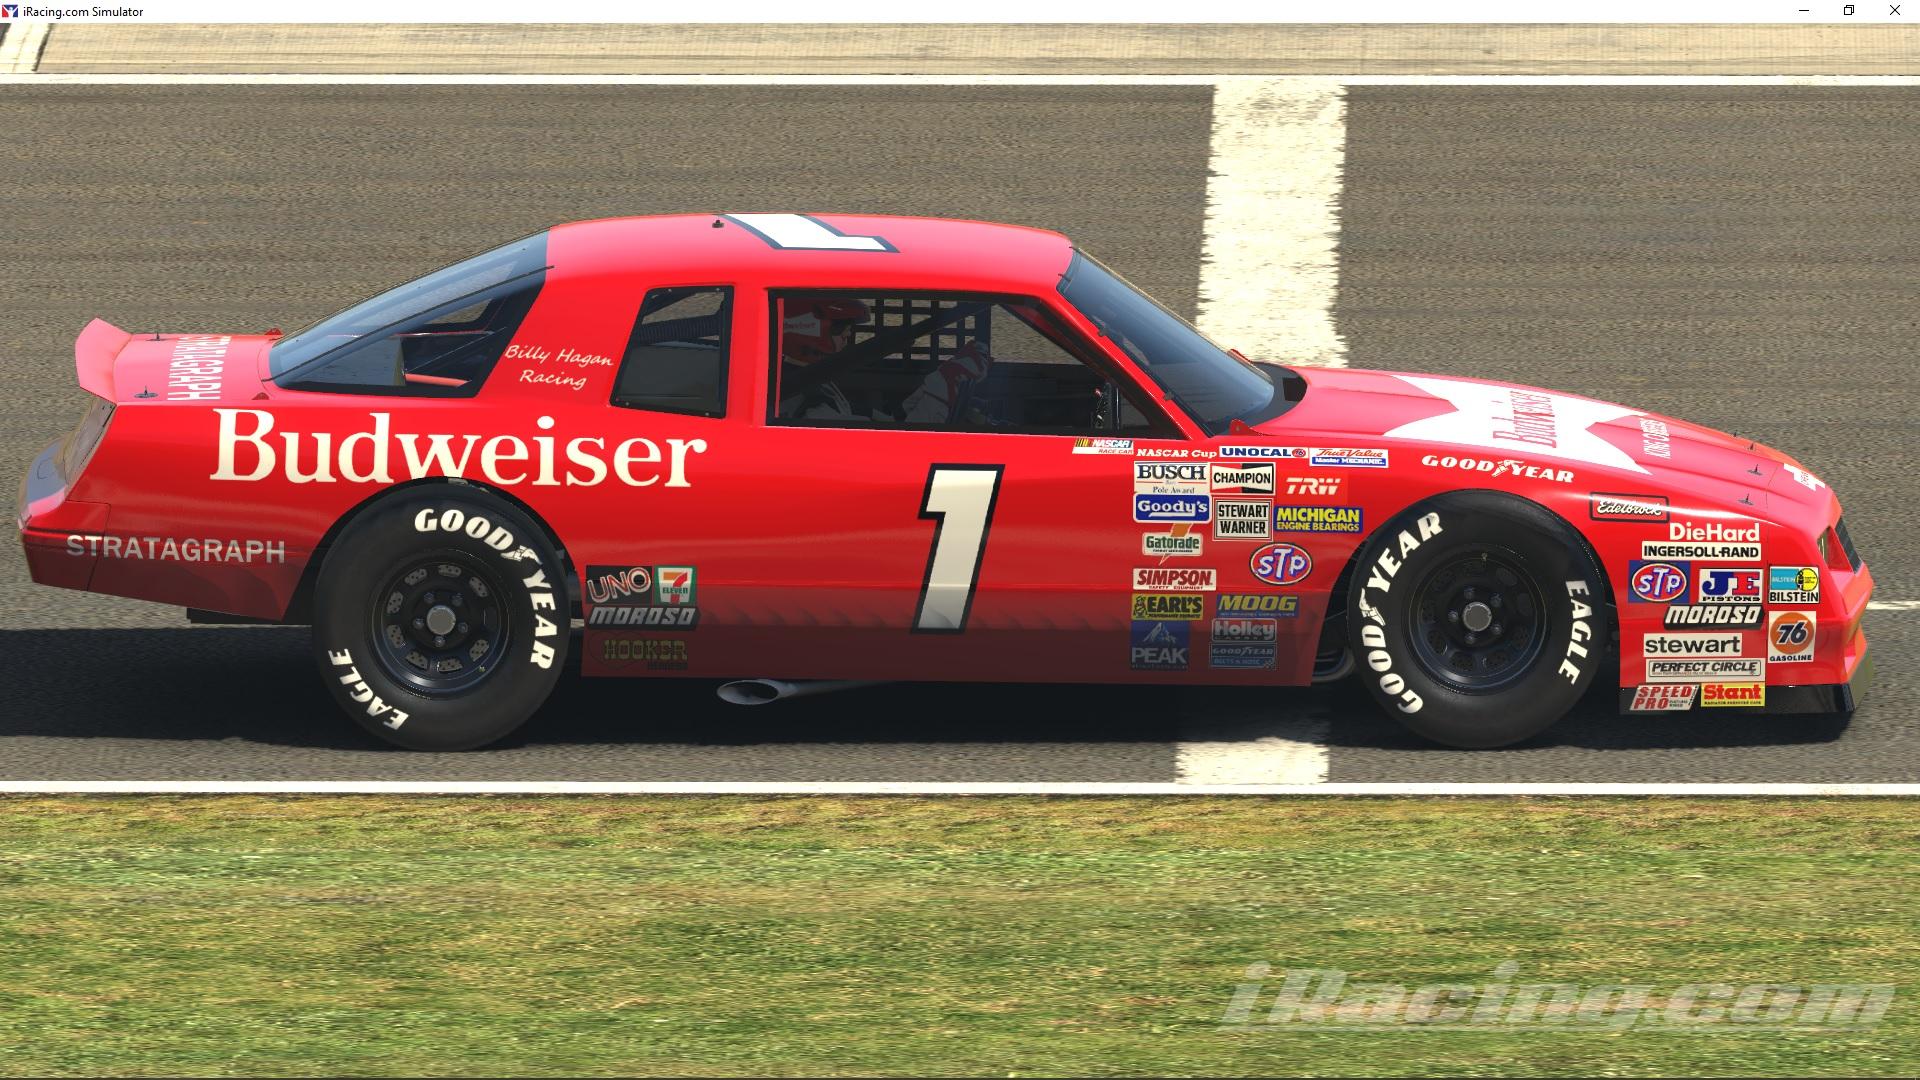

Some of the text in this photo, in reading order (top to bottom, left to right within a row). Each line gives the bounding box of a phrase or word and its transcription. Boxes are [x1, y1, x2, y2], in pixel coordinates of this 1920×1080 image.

[23, 7, 143, 19] iRacing.com Simulator
[504, 345, 614, 368] Billy Hagan
[519, 369, 587, 391] Racing
[209, 408, 707, 488] Budweiser
[1091, 439, 1128, 448] NASCAR
[1221, 447, 1291, 457] UNOCAL
[1136, 448, 1217, 459] NASCAR Cup
[1136, 464, 1206, 480] BUSCH
[1213, 472, 1271, 484] CHAMPION
[1152, 486, 1168, 494] Pole
[1286, 477, 1341, 496] TRW
[1137, 500, 1208, 518] Goody's
[1218, 504, 1268, 518] STEWART
[1597, 496, 1662, 516] Edelbrock
[1277, 507, 1360, 523] MICHIGAN
[1220, 521, 1266, 534] WARNER
[1277, 521, 1360, 532] ENGINE BEARINGS
[1669, 522, 1760, 541] DieHard
[66, 534, 285, 563] STRATAGRAPH
[910, 462, 1006, 636] 1
[1146, 535, 1200, 549] Gatorade
[1643, 545, 1759, 558] INGERSOLL-RAND
[1257, 547, 1306, 579] STP
[587, 567, 652, 603] UNO
[1137, 570, 1212, 586] SIMPSON
[1637, 567, 1682, 597] STP
[1702, 571, 1761, 596] JE
[1147, 596, 1202, 613] EARL'S
[1218, 595, 1298, 611] MOOG
[1769, 591, 1819, 602] BILSTEIN
[588, 606, 696, 625] MOROSO
[1664, 605, 1761, 624] MOROSO
[1214, 620, 1275, 640] Holley
[1558, 580, 1593, 685] EAGLE
[1776, 620, 1809, 645] 76
[603, 640, 688, 660] HOOKER
[1645, 636, 1741, 653] stewart
[1131, 647, 1188, 664] PEAK
[1769, 654, 1813, 662] GASOLINE
[1651, 661, 1758, 672] PERFECT CIRCLE
[328, 648, 409, 730] EAGLE
[1638, 686, 1693, 698] SPEED
[1703, 684, 1762, 700] Stant
[1633, 698, 1669, 709] PRO
